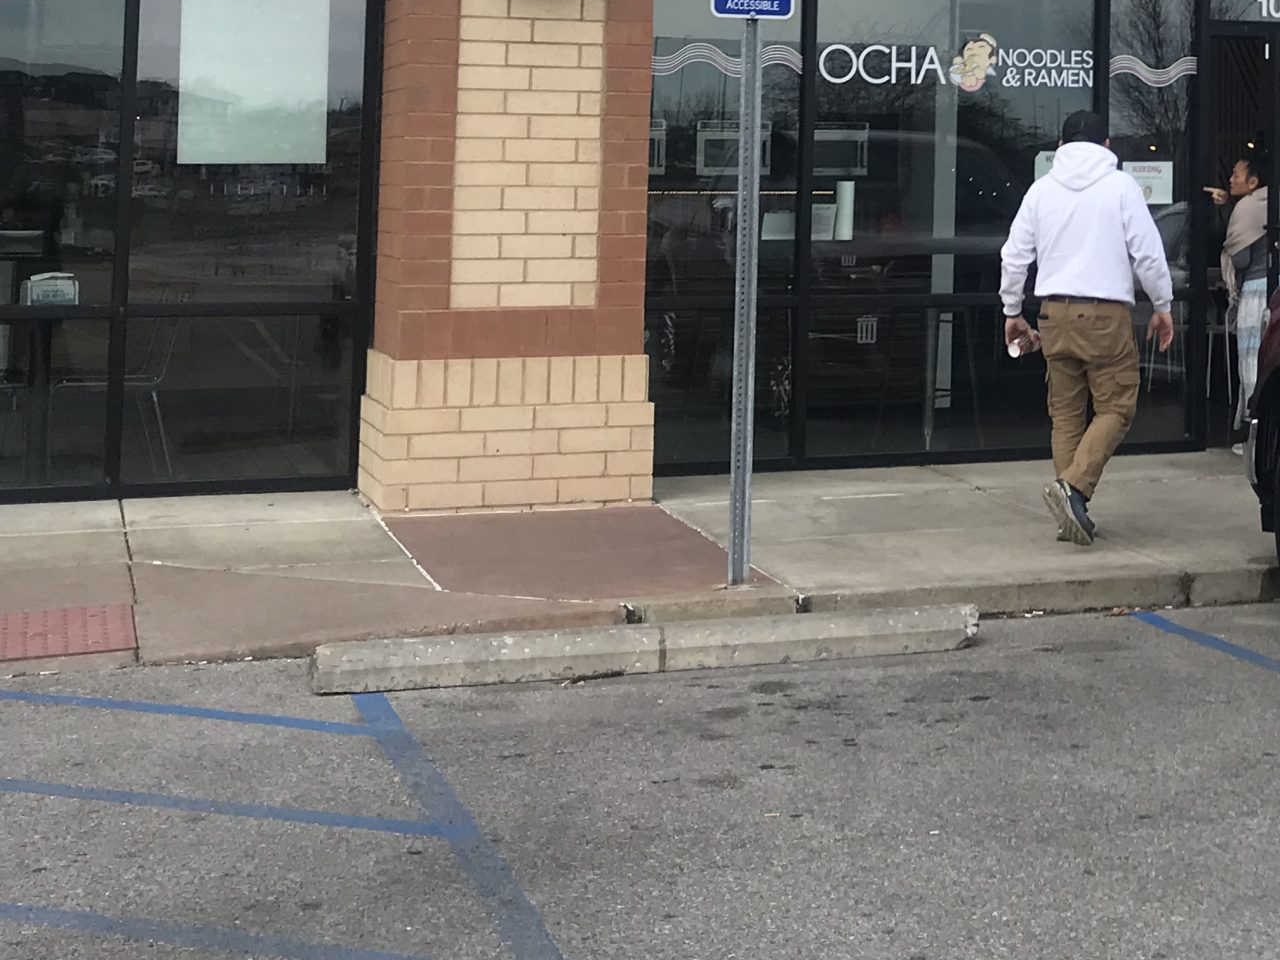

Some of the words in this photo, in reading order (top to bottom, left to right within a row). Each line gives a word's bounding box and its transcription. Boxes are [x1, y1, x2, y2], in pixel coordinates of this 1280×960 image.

[725, 0, 780, 11] ACCESSIBLE
[818, 43, 946, 85] OCHA
[998, 48, 1094, 68] NOODLES
[1001, 67, 1021, 88] &
[1024, 68, 1094, 88] RAMEN
